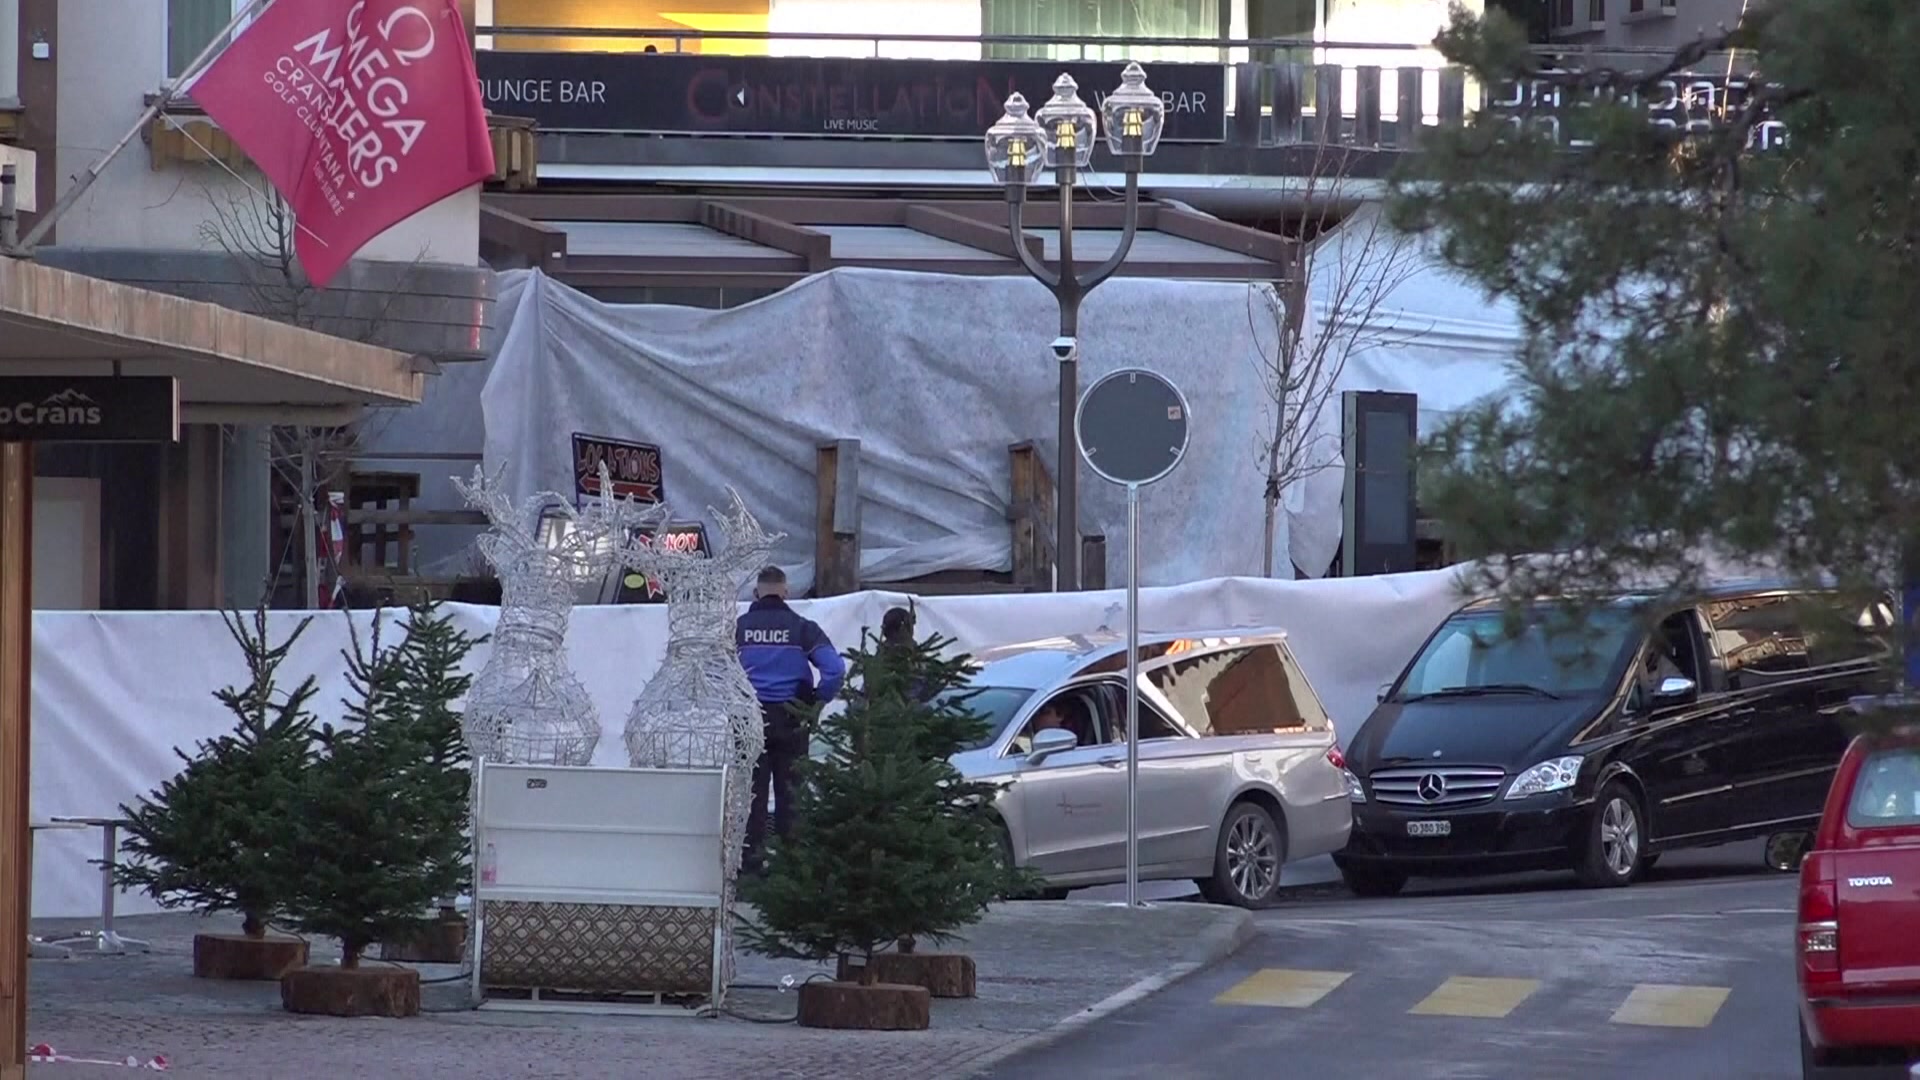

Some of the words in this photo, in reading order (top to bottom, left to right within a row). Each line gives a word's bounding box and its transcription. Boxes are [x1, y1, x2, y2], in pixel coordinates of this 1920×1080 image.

[263, 71, 298, 105] GOLF
[476, 79, 552, 102] OUNGE
[560, 81, 605, 103] BAR
[1161, 91, 1206, 113] BAR
[823, 119, 845, 130] LIVE
[847, 119, 878, 130] MUSIC
[744, 629, 790, 643] POLICE
[1848, 876, 1893, 887] TOYOTA
